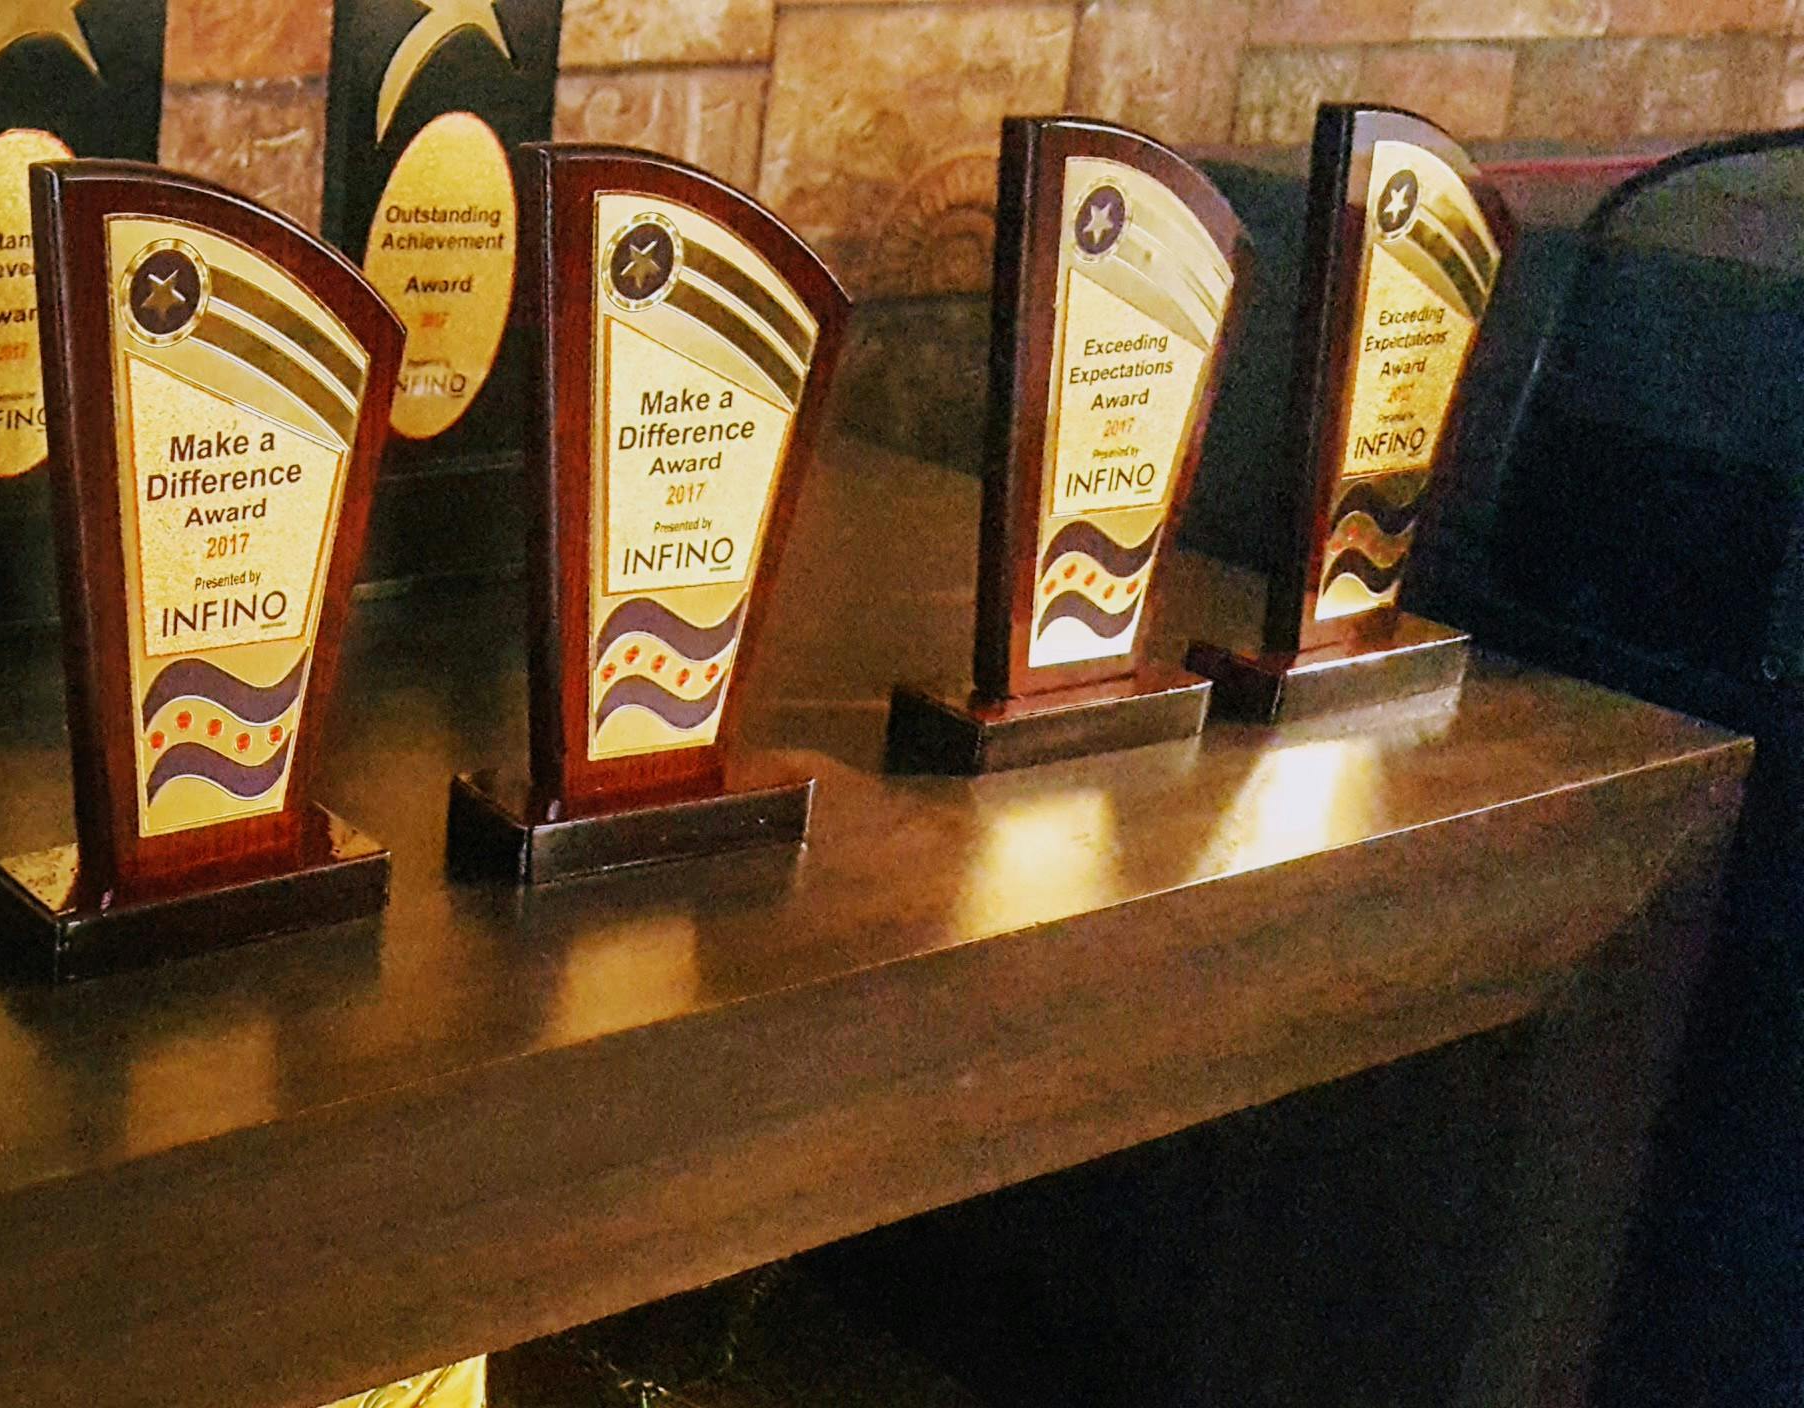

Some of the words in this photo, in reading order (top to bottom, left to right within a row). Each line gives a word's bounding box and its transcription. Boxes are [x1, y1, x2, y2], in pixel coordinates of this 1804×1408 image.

[386, 205, 501, 228] Outstanding
[381, 232, 504, 250] Achievement
[404, 276, 472, 293] Award
[1379, 306, 1445, 326] Exceeding
[1084, 334, 1168, 356] Exceeding
[1365, 330, 1449, 352] Expectations
[1069, 359, 1174, 386] Expectations
[1380, 357, 1427, 377] Award
[397, 374, 466, 393] NFINO
[641, 389, 710, 416] Make
[719, 391, 733, 408] a
[1091, 388, 1149, 410] Award
[170, 431, 249, 463] Make
[260, 432, 275, 451] a
[618, 421, 755, 450] Difference
[1354, 427, 1426, 459] INFINO
[649, 452, 722, 476] Award
[147, 464, 302, 501] Difference
[1066, 463, 1155, 497] INFINO
[666, 482, 706, 506] 2017
[185, 498, 267, 528] Award
[654, 519, 699, 533] Presented
[702, 518, 712, 531] by
[206, 533, 250, 559] 2017
[623, 537, 734, 575] INFINO
[195, 573, 246, 591] Presented
[249, 570, 261, 585] by
[162, 591, 287, 638] INFINO
